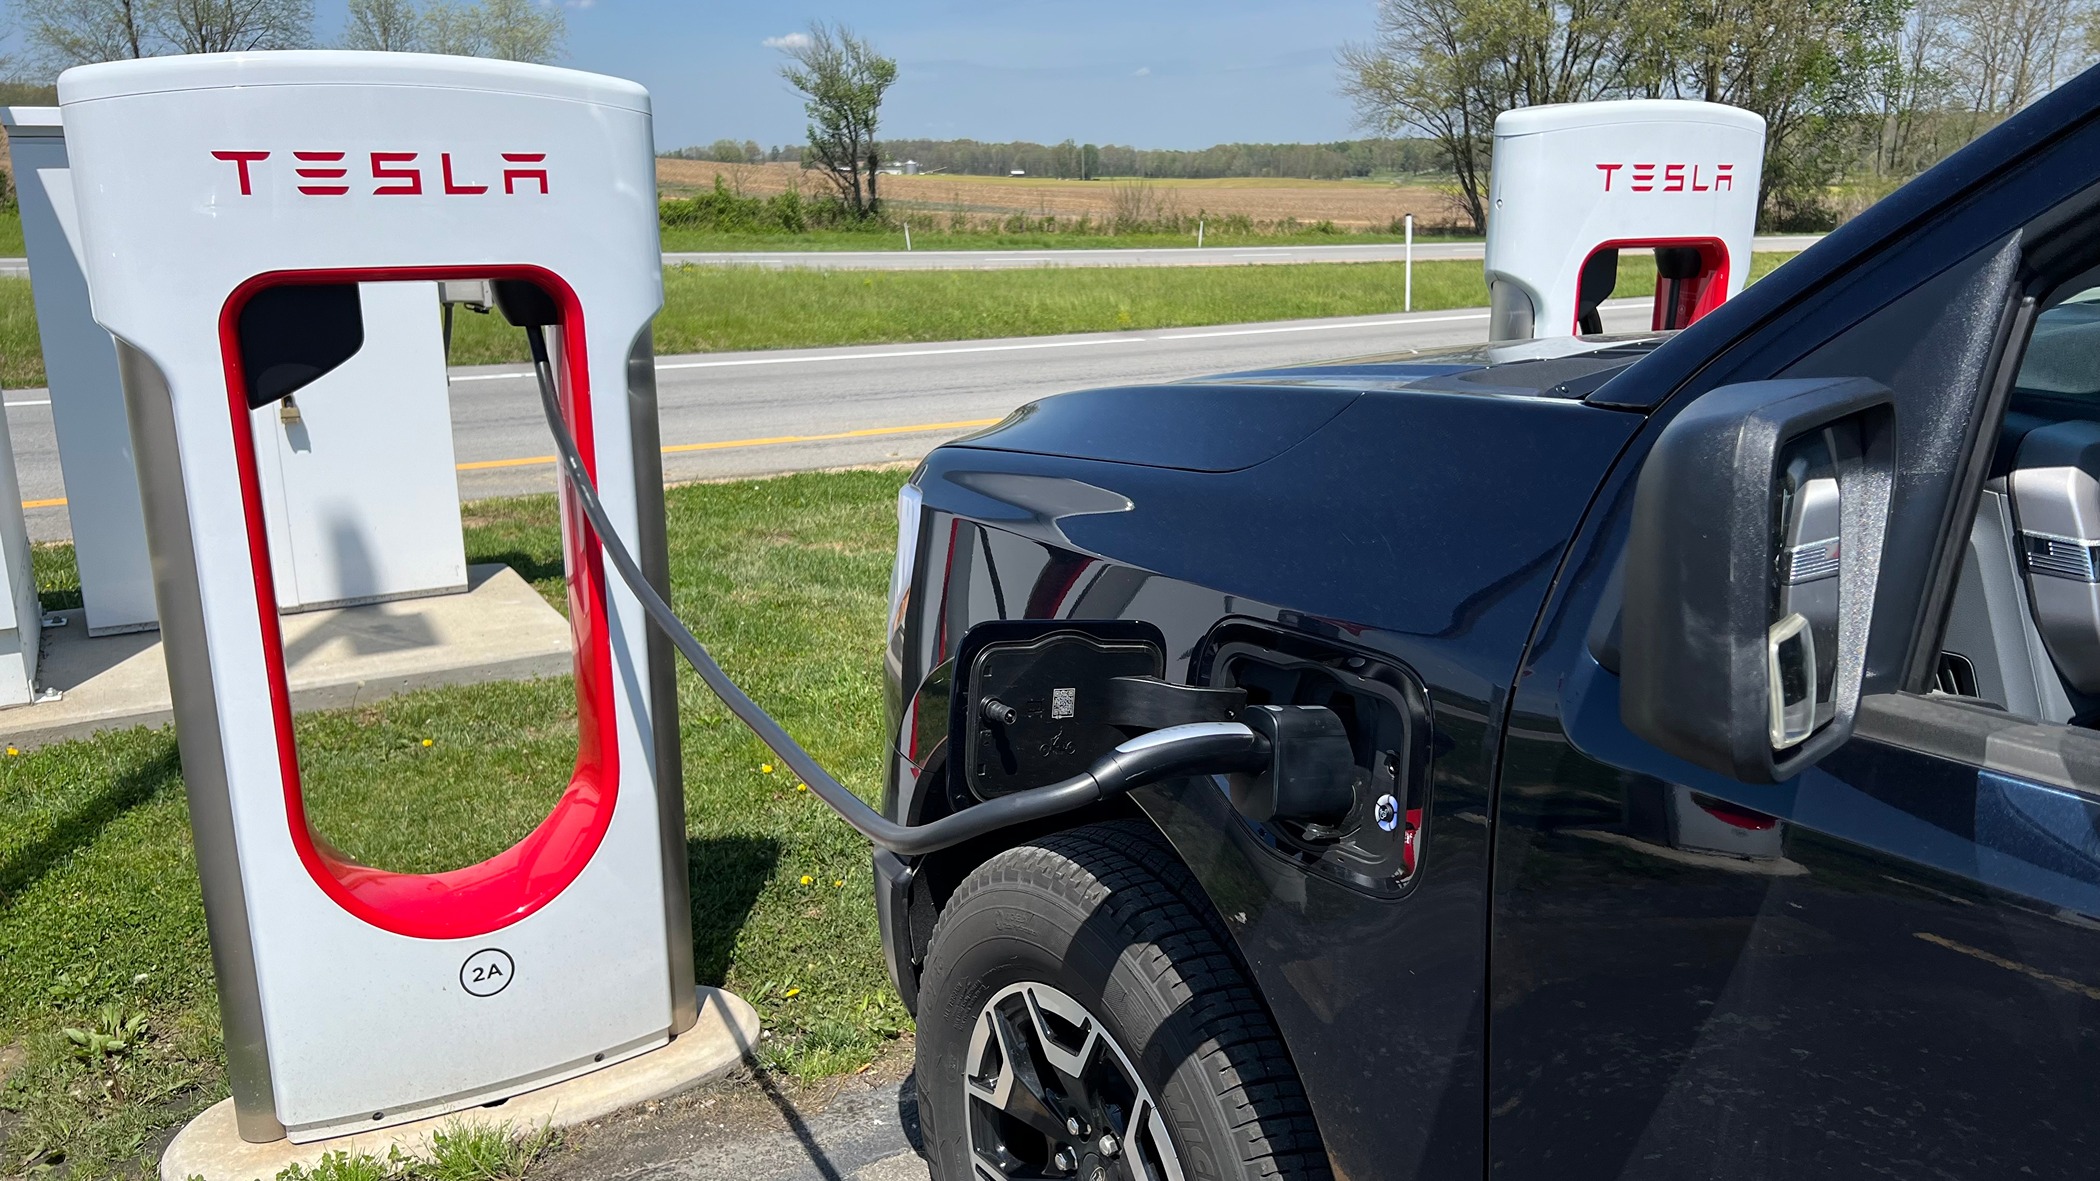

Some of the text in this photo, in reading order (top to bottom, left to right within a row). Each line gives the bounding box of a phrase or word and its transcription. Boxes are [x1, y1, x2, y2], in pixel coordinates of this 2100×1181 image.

[211, 151, 549, 196] TESLA
[1595, 164, 1733, 192] TESLA
[472, 963, 503, 983] 2A
